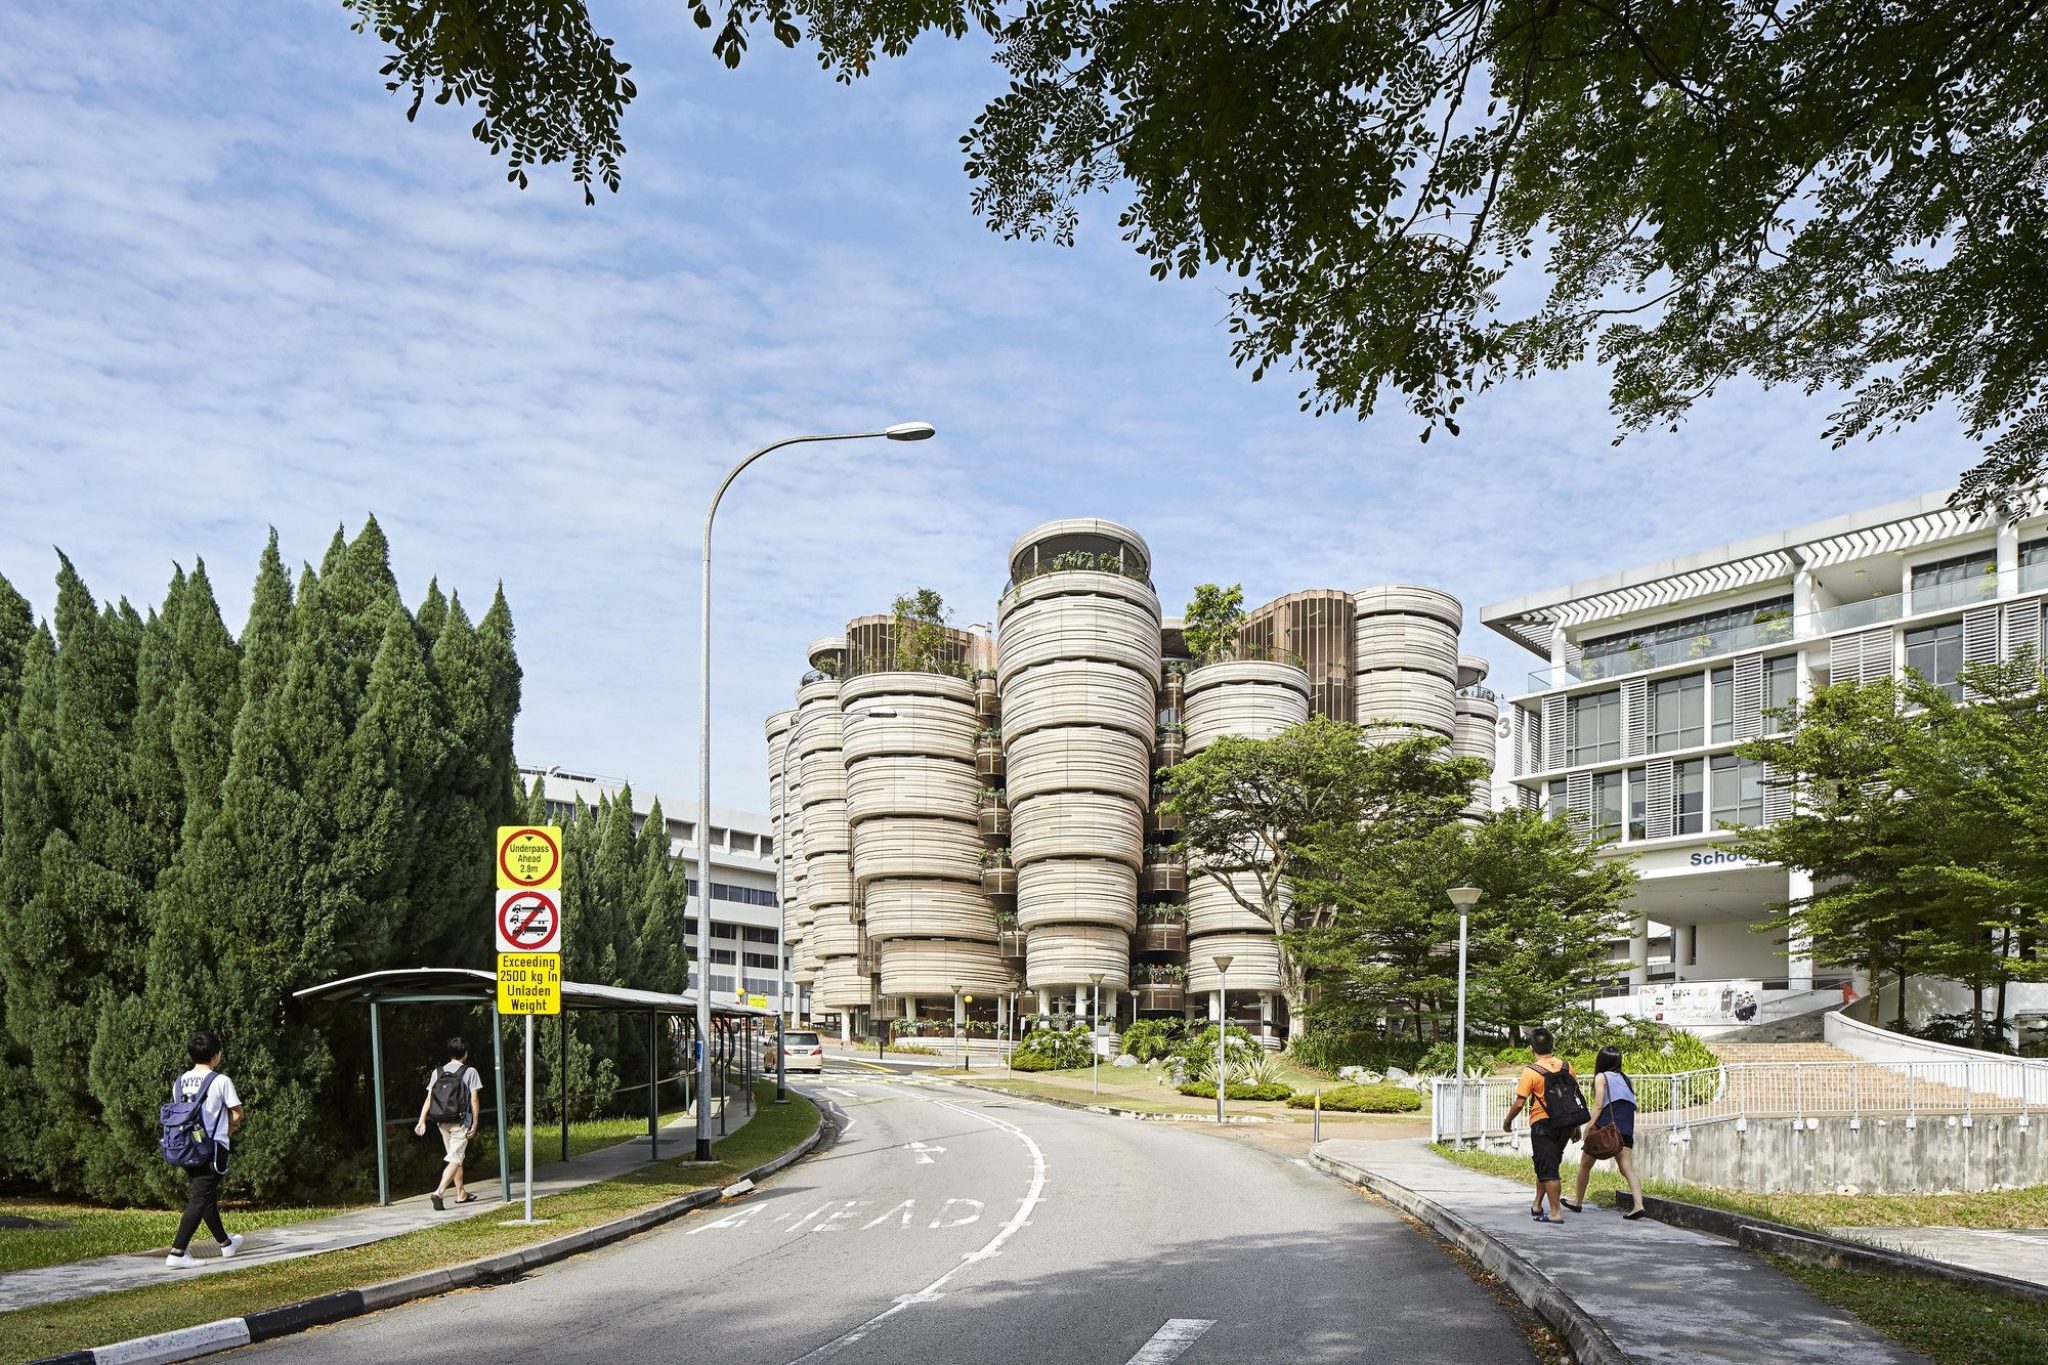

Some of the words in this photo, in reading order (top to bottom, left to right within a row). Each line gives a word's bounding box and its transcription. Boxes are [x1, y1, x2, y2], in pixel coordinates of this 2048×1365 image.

[509, 844, 550, 854] Underpass
[517, 854, 542, 863] Ahead
[1690, 849, 1750, 866] Schoo
[520, 864, 539, 873] 2.8m
[503, 955, 555, 971] Exceeding
[500, 970, 526, 982] 2500
[531, 970, 543, 985] kg
[548, 970, 558, 982] In
[507, 984, 551, 996] Unladen
[511, 999, 547, 1013] Weight
